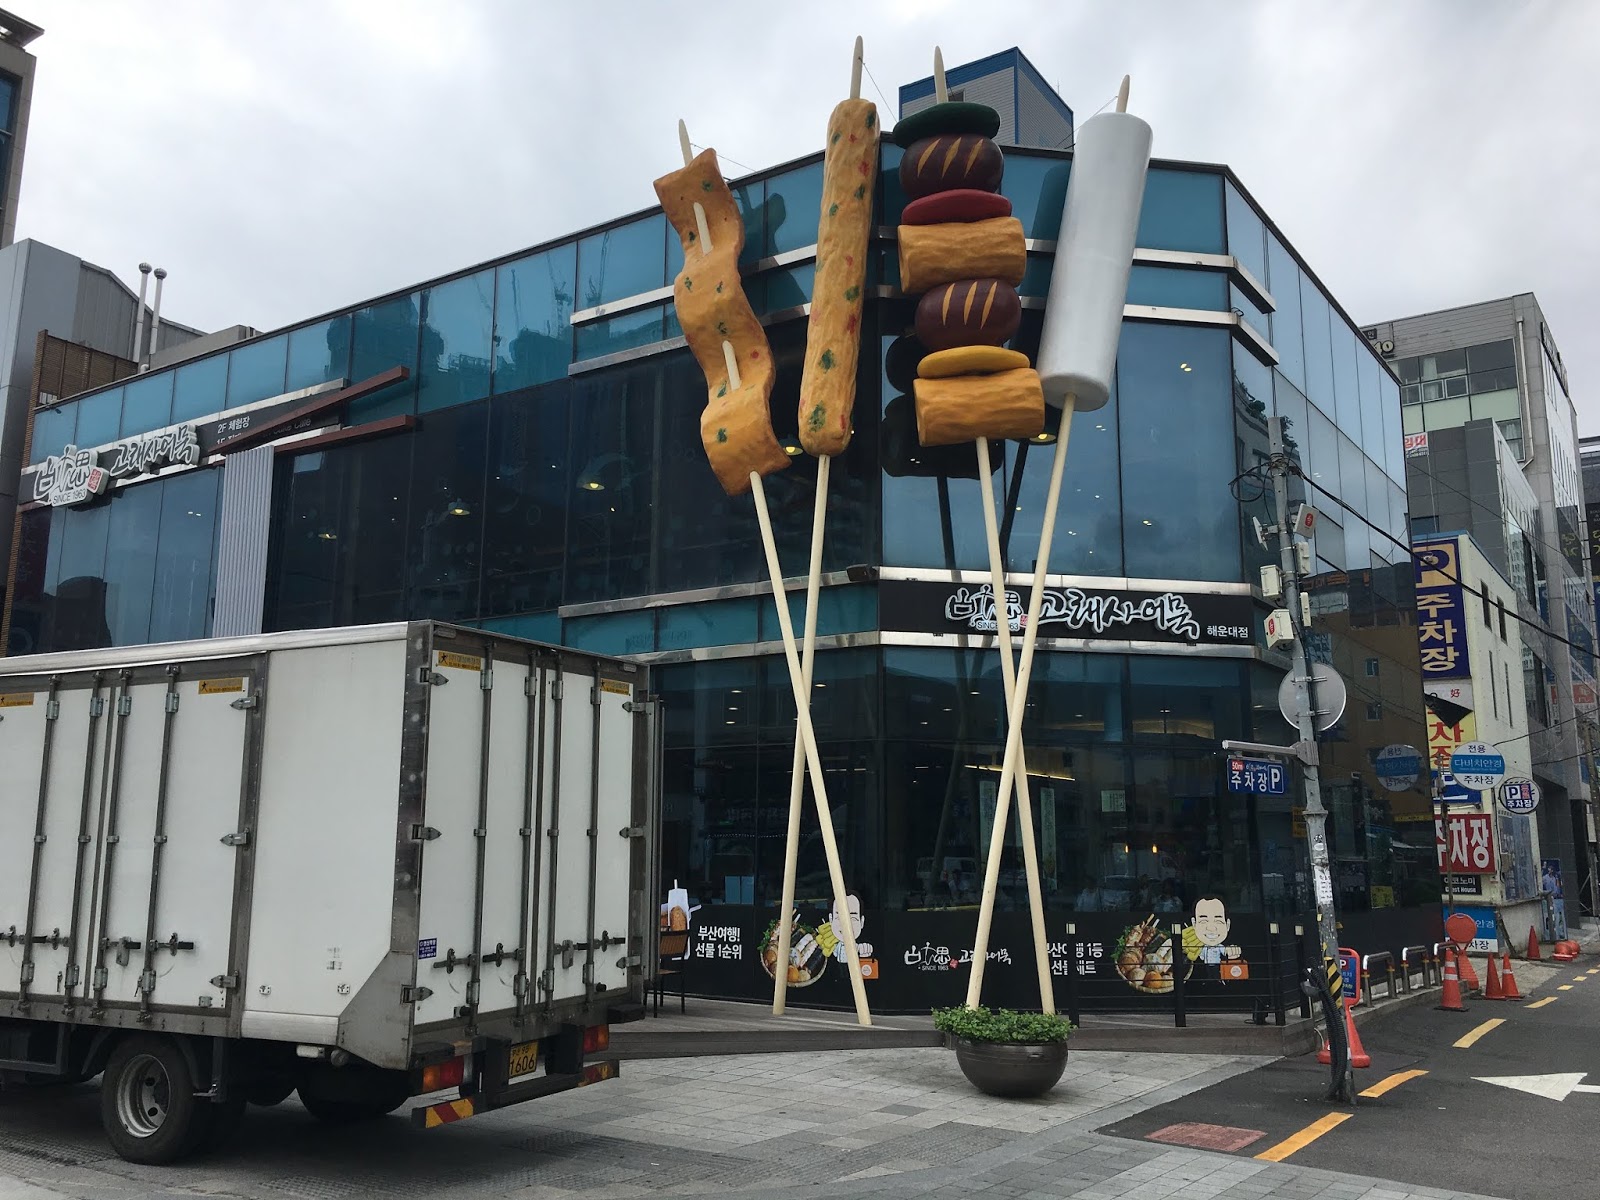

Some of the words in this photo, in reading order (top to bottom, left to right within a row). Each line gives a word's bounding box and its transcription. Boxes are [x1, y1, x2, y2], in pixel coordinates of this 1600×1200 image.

[217, 422, 227, 434] 2F
[228, 416, 250, 431] 체험장
[52, 491, 71, 505] SINCE
[72, 489, 87, 500] 1963
[1206, 625, 1249, 638] 해운대점
[1417, 593, 1459, 672] 주차장
[1468, 744, 1487, 753] 전용
[1454, 759, 1502, 768] 다비치안경
[1231, 771, 1268, 792] 주차장
[1271, 768, 1281, 789] P
[1464, 775, 1494, 785] 주차장
[1508, 786, 1519, 799] P
[1507, 799, 1532, 808] 주차장
[697, 925, 741, 943] 부산여행!
[695, 942, 715, 959] 선물
[718, 943, 742, 960] 1순위
[1087, 942, 1104, 958] 1등
[510, 1053, 535, 1075] 1606
